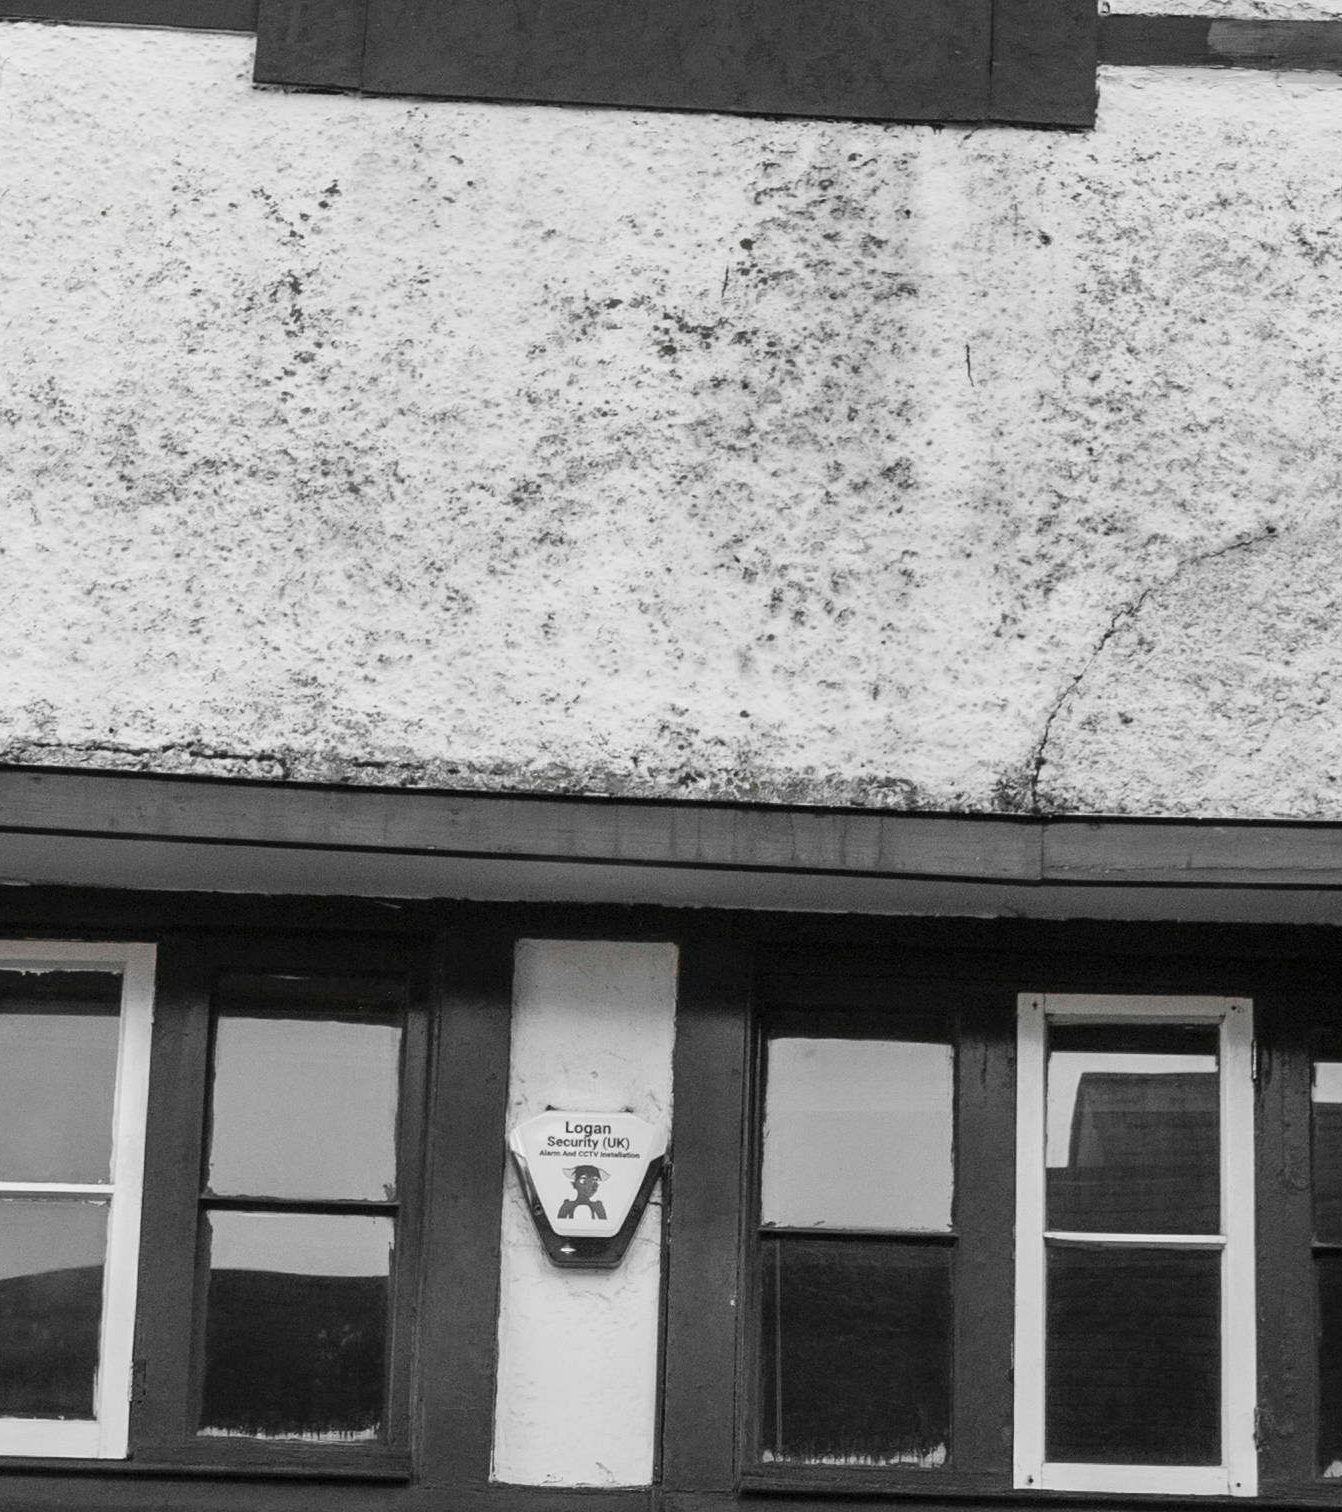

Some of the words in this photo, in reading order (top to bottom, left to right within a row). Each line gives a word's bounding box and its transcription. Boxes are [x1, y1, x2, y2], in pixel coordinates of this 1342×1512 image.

[565, 1121, 612, 1138] Logan
[547, 1136, 599, 1150] Security
[602, 1137, 630, 1151] (UK)
[539, 1149, 561, 1157] Alarm
[578, 1150, 599, 1158] CCTV
[600, 1150, 640, 1159] Installation
